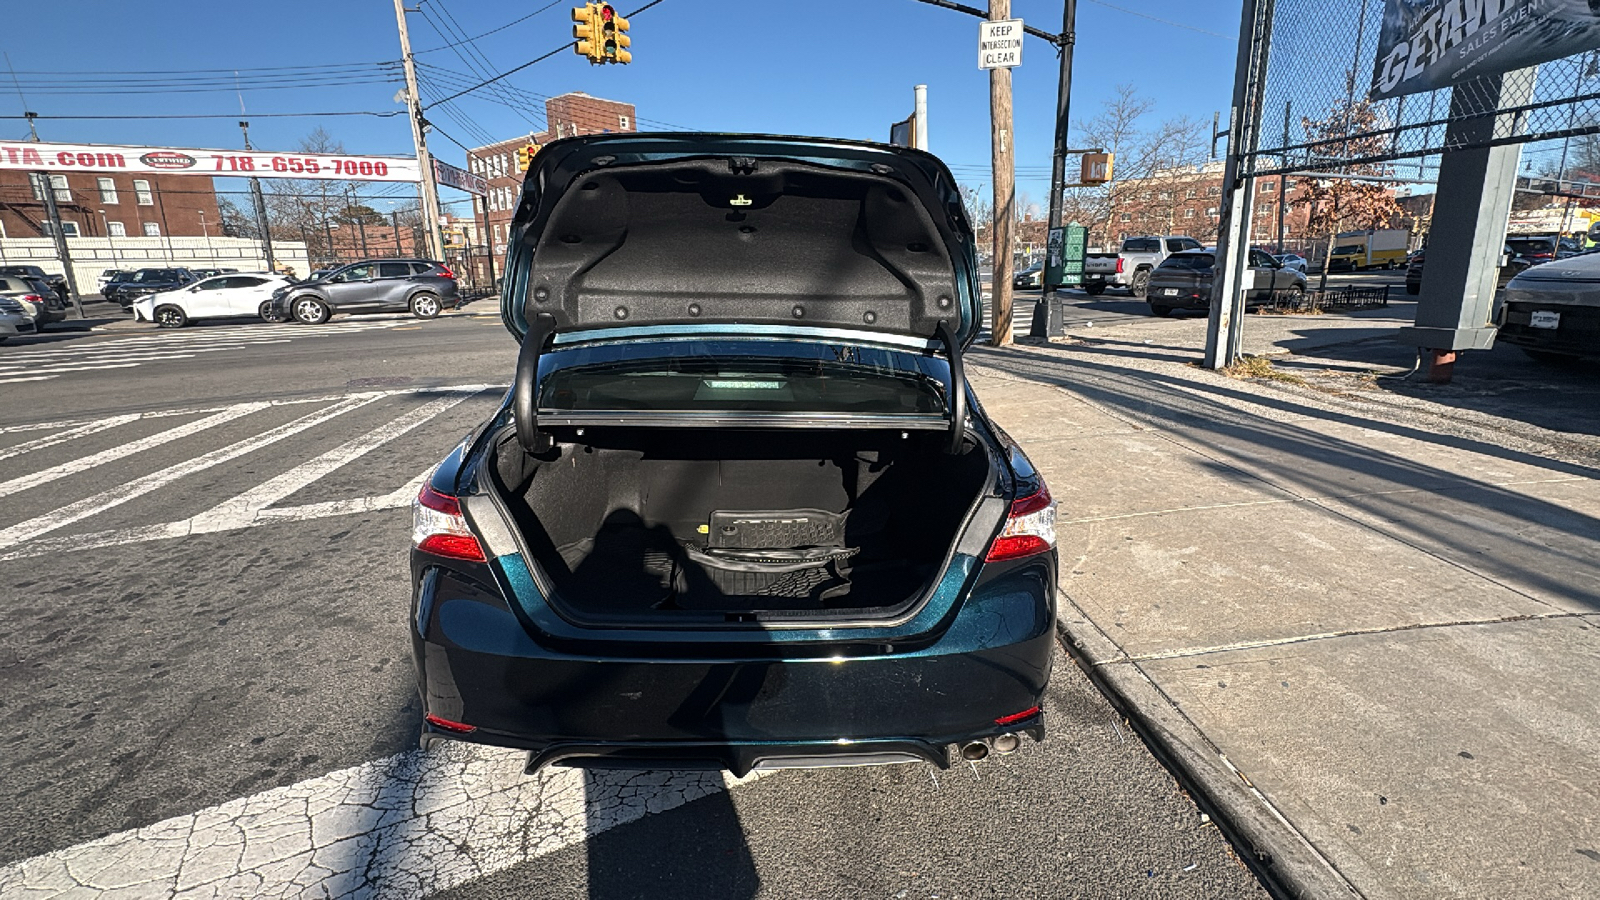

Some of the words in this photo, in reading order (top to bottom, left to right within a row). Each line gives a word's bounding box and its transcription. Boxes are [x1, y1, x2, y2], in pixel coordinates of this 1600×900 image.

[989, 25, 1012, 37] KEEP
[981, 38, 1020, 50] INTERSECTION
[1459, 26, 1497, 59] SALES
[986, 52, 1014, 64] CLEAR
[0, 146, 126, 168] TA.com
[210, 155, 388, 176] 718-655-7000
